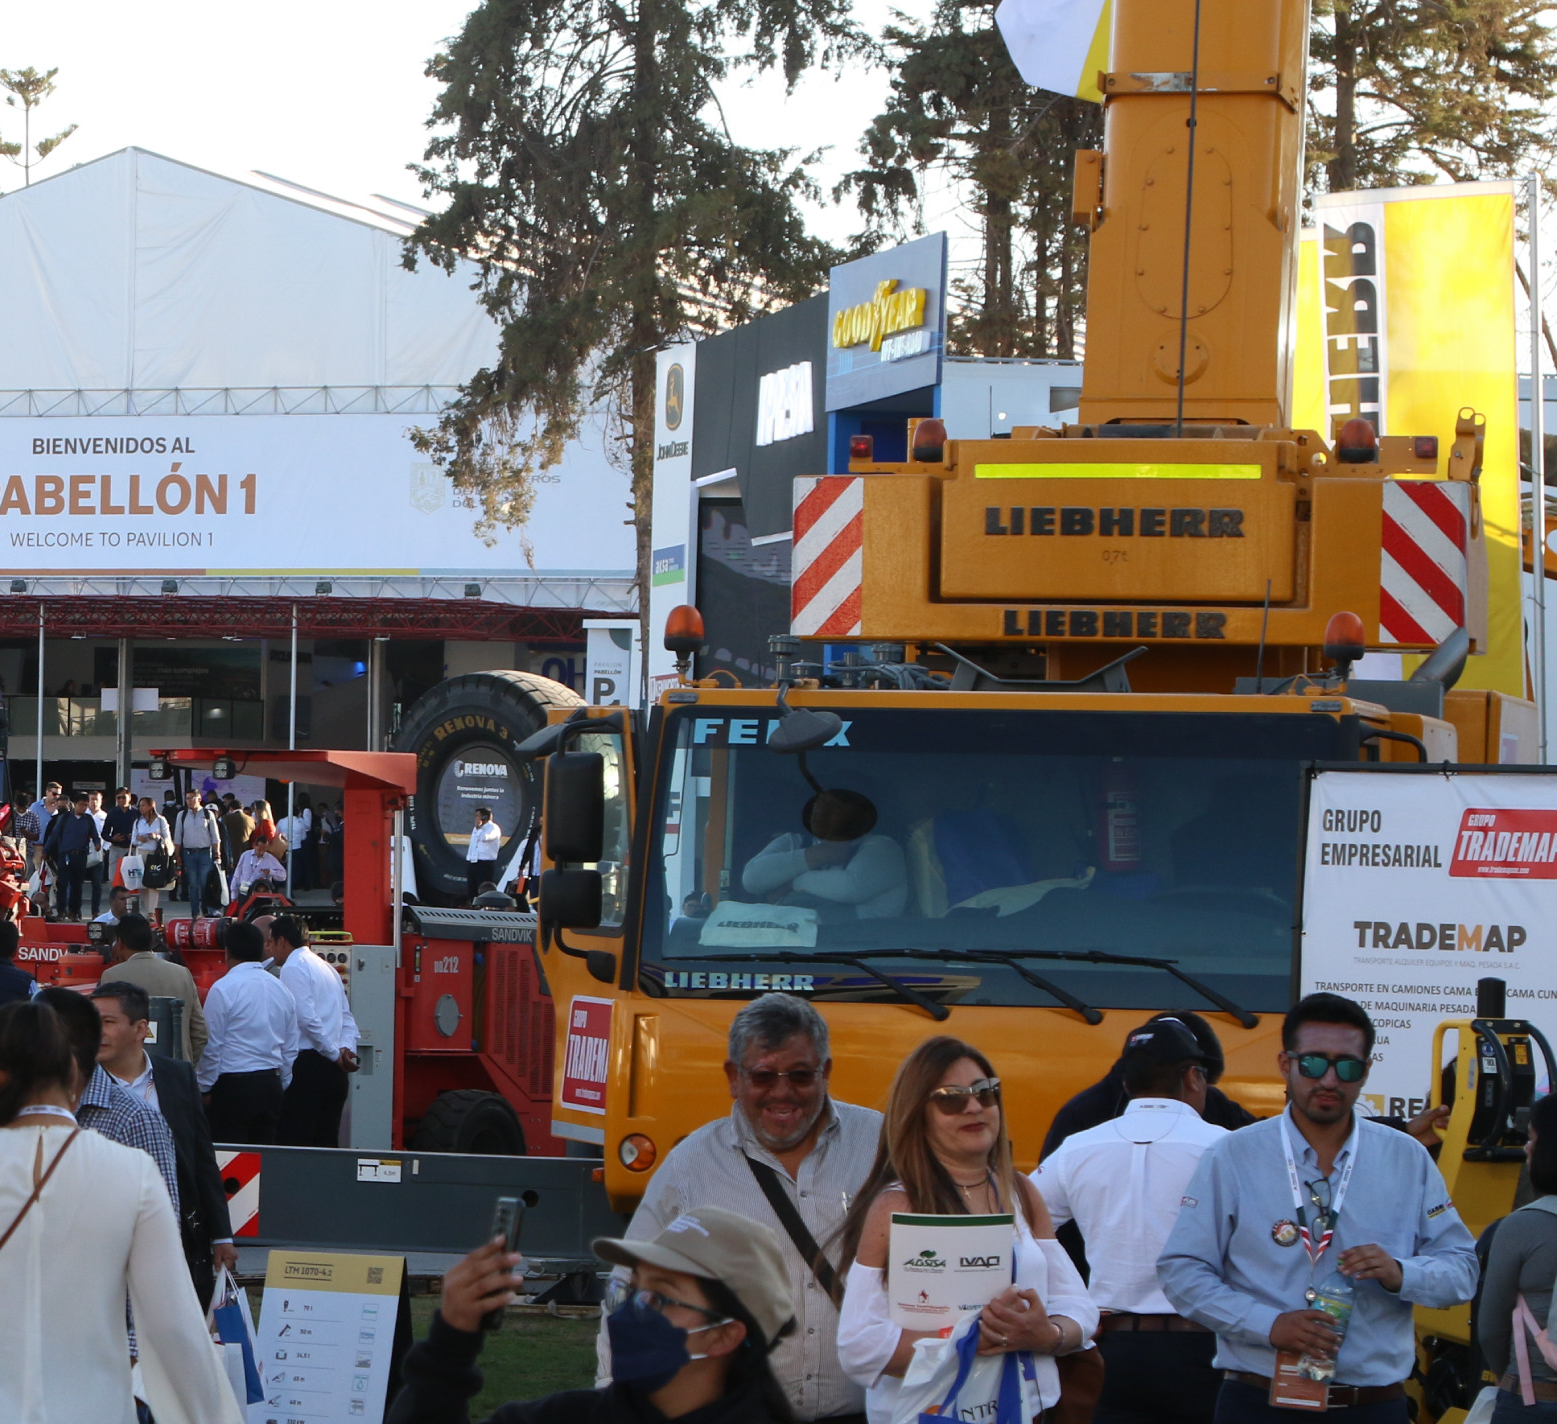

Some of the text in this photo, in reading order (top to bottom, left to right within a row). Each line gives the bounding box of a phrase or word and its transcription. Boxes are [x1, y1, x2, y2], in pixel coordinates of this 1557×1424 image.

[833, 280, 923, 351] GOODYEAR
[32, 437, 195, 455] BIENVENIDOS AL
[239, 473, 257, 515] 1
[985, 506, 1246, 538] LIEBHERR
[10, 532, 214, 547] WELCOME TO PAVILION 1
[1004, 609, 1228, 639] LIEBHERR
[434, 715, 509, 741] RENOVA 3
[464, 763, 508, 776] RENOVA
[1322, 808, 1382, 833] GRUPO
[1467, 814, 1497, 827] GRUPO
[1320, 842, 1443, 868] EMPRESARIAL
[492, 927, 533, 942] SANDVIK
[1353, 921, 1527, 953] TRADEMAP
[1353, 956, 1393, 966] TRANSPORTE
[1394, 957, 1424, 967] ALQUILER
[1425, 958, 1453, 967] EQUIPOS
[1479, 960, 1501, 969] PESADA
[663, 971, 815, 991] LIEBHERR
[1315, 981, 1374, 993] TRANSPORTE
[1377, 983, 1389, 993] EN
[1391, 984, 1441, 995] CAMIONES
[1443, 986, 1472, 996] CAMA
[1507, 988, 1536, 999] CAMA
[1360, 1001, 1476, 1014] DE MAQUINARIA PESADA
[284, 1265, 300, 1275] LTM
